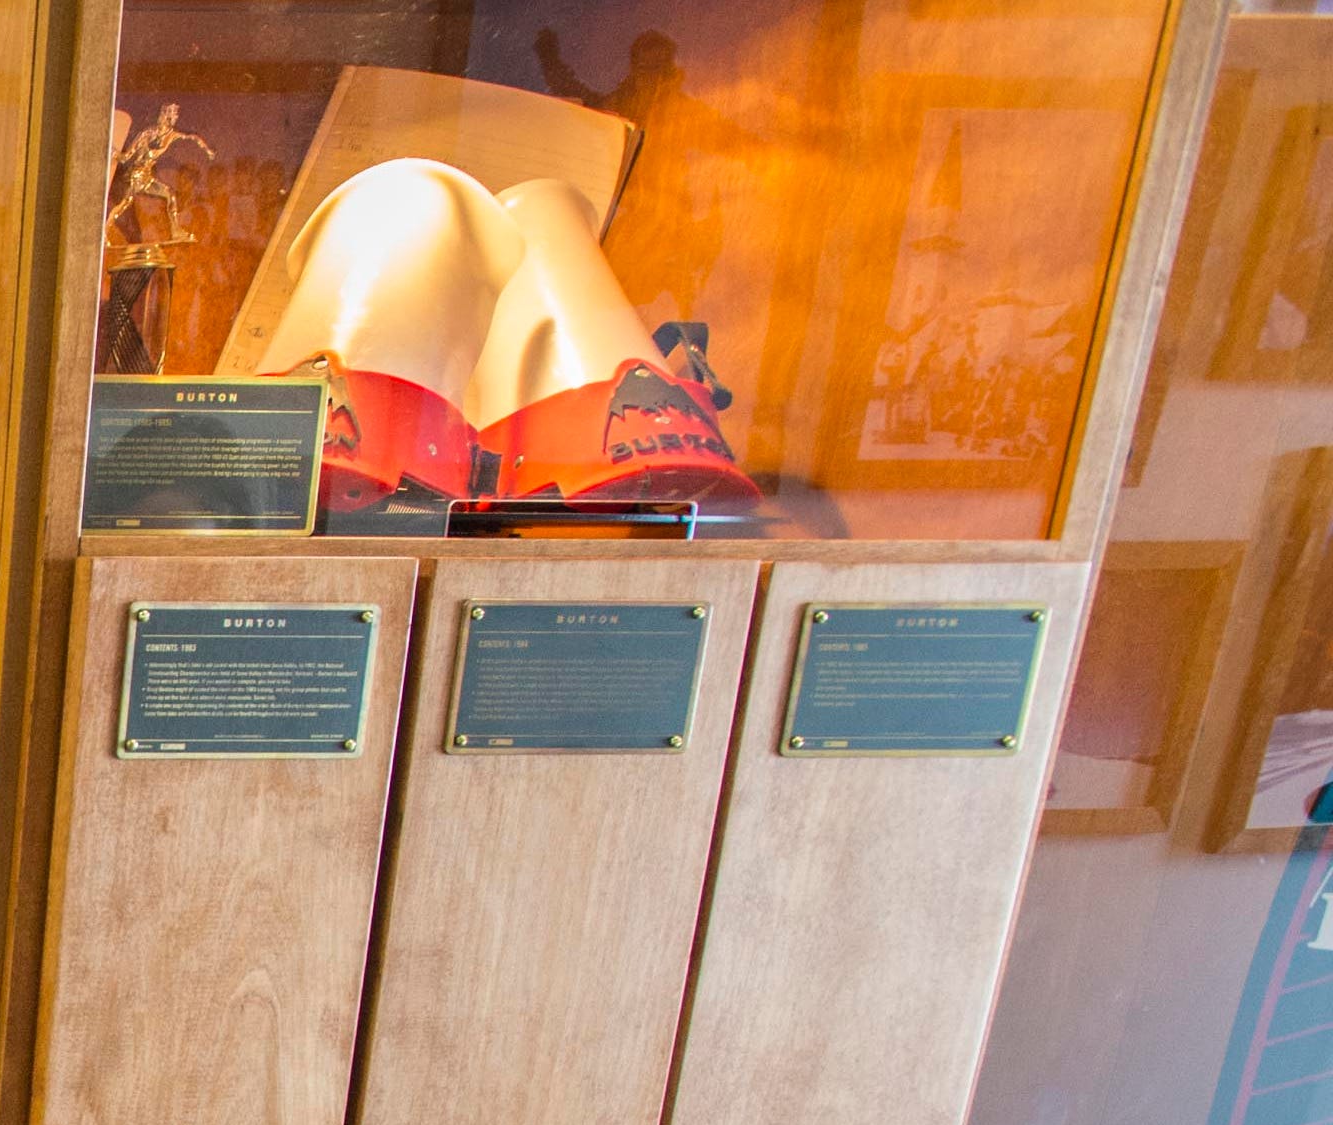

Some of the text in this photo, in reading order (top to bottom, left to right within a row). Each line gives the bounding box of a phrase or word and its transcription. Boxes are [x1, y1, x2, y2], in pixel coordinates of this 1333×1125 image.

[175, 392, 238, 402] BURTON
[223, 618, 287, 628] BURTON
[556, 615, 619, 625] BURTON
[895, 618, 959, 628] BURTON
